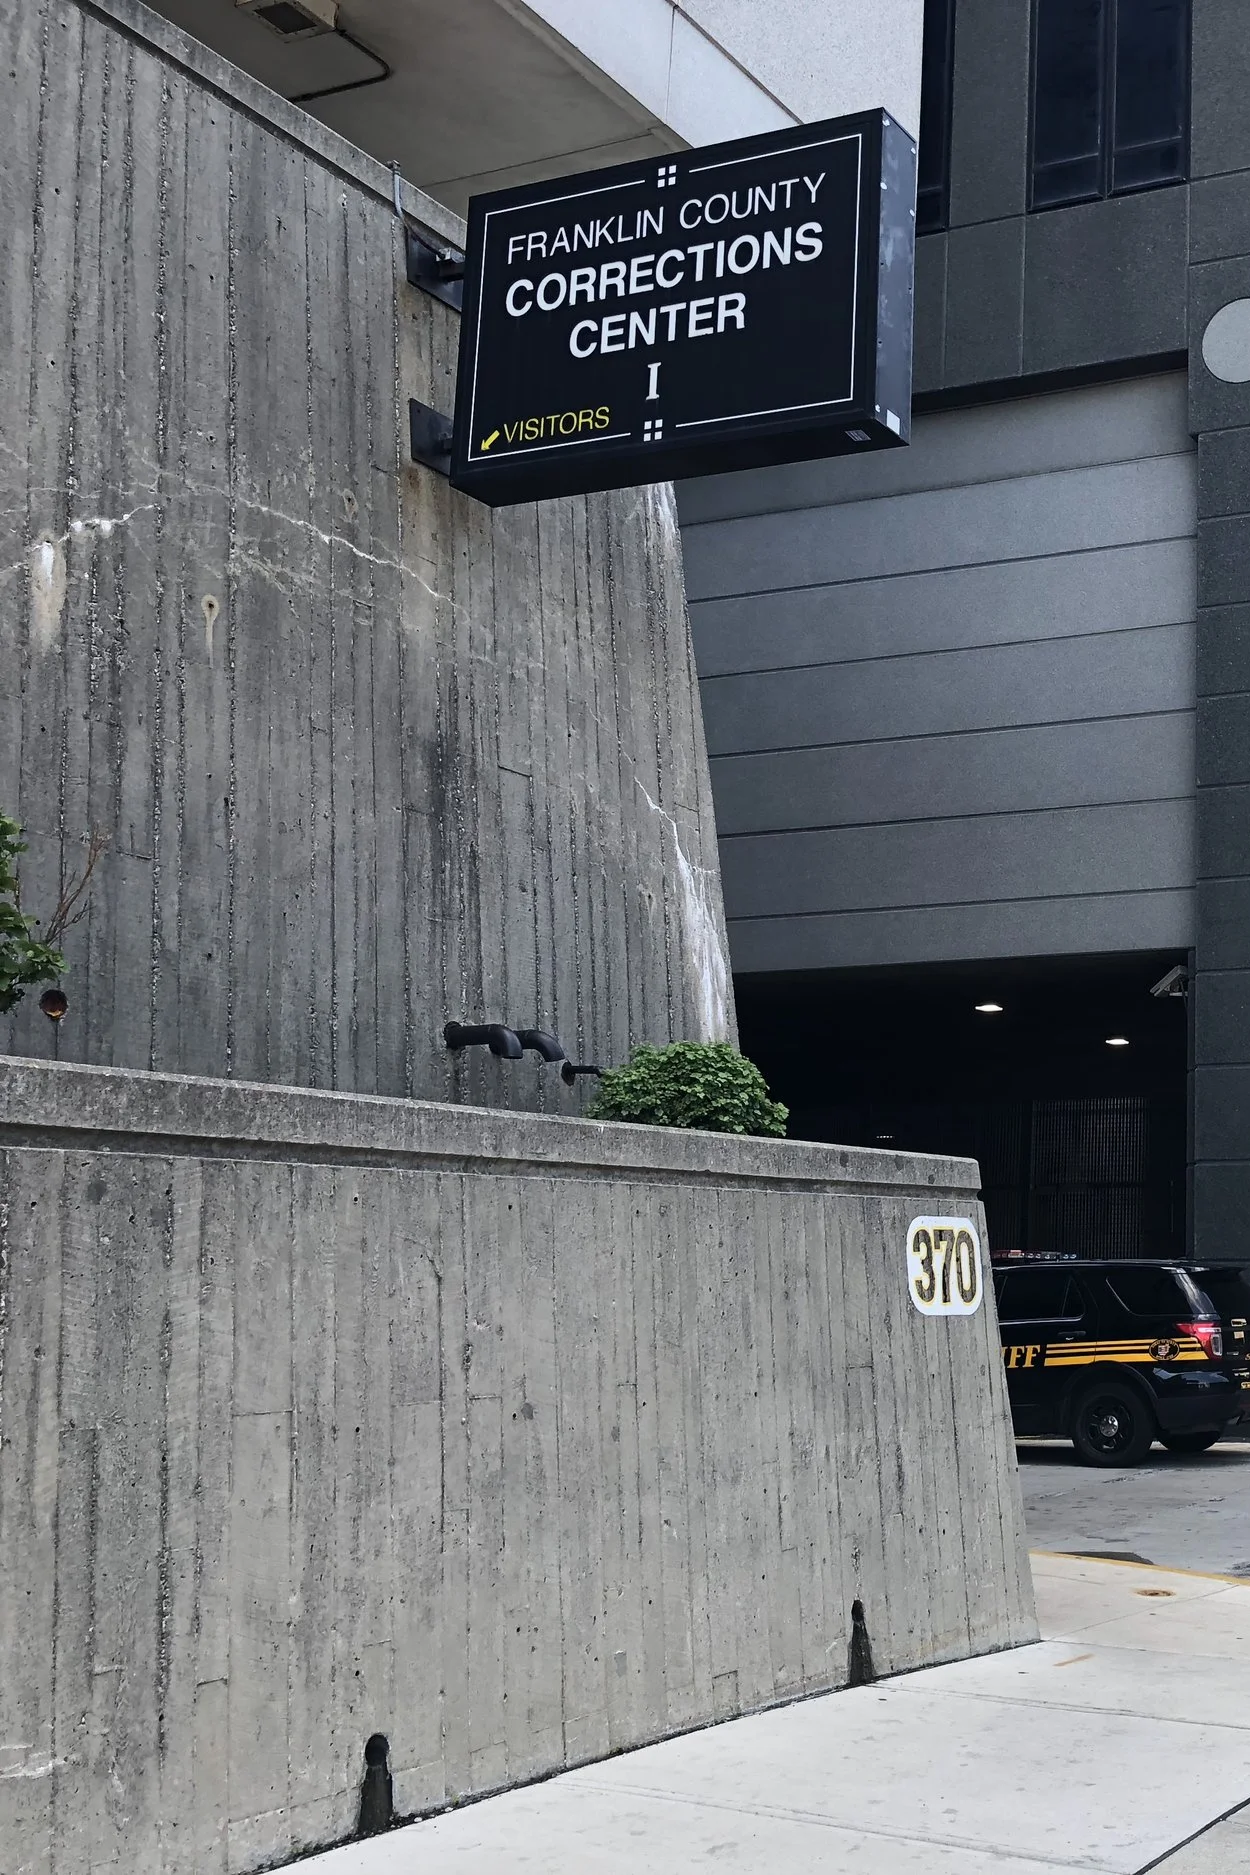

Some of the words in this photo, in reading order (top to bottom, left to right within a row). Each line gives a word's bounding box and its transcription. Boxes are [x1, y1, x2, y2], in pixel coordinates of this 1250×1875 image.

[507, 205, 665, 265] FRANKLIN
[679, 172, 826, 230] COUNTY
[505, 221, 823, 317] CORRECTIONS
[569, 292, 747, 359] CENTER
[645, 362, 662, 401] I
[503, 406, 610, 444] VISITORS
[911, 1227, 978, 1305] 370
